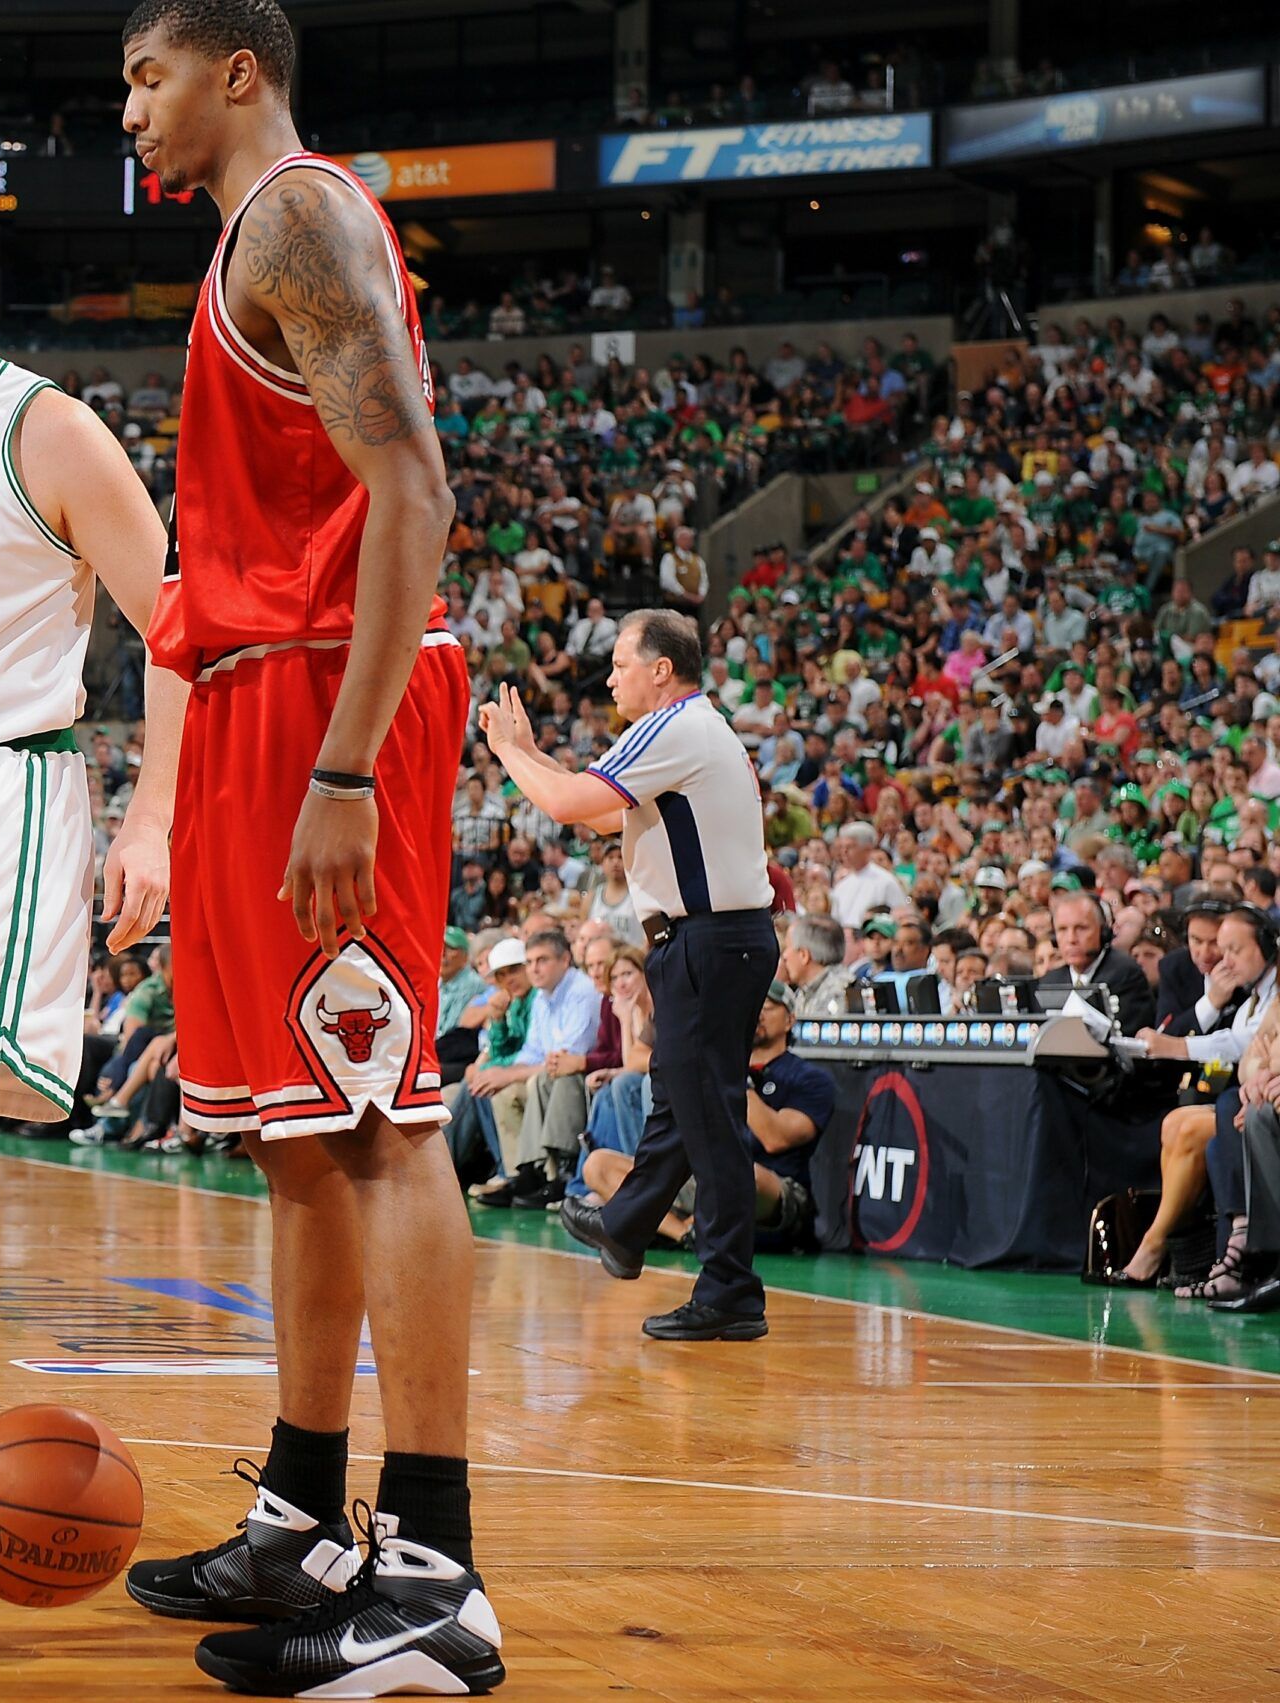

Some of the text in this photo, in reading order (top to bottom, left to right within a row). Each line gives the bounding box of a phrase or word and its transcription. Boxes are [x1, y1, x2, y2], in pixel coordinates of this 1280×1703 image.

[756, 117, 905, 148] FITNESS
[610, 128, 746, 184] FT
[735, 143, 923, 178] TOGETHER
[397, 160, 450, 188] at&t
[854, 1144, 915, 1202] NT
